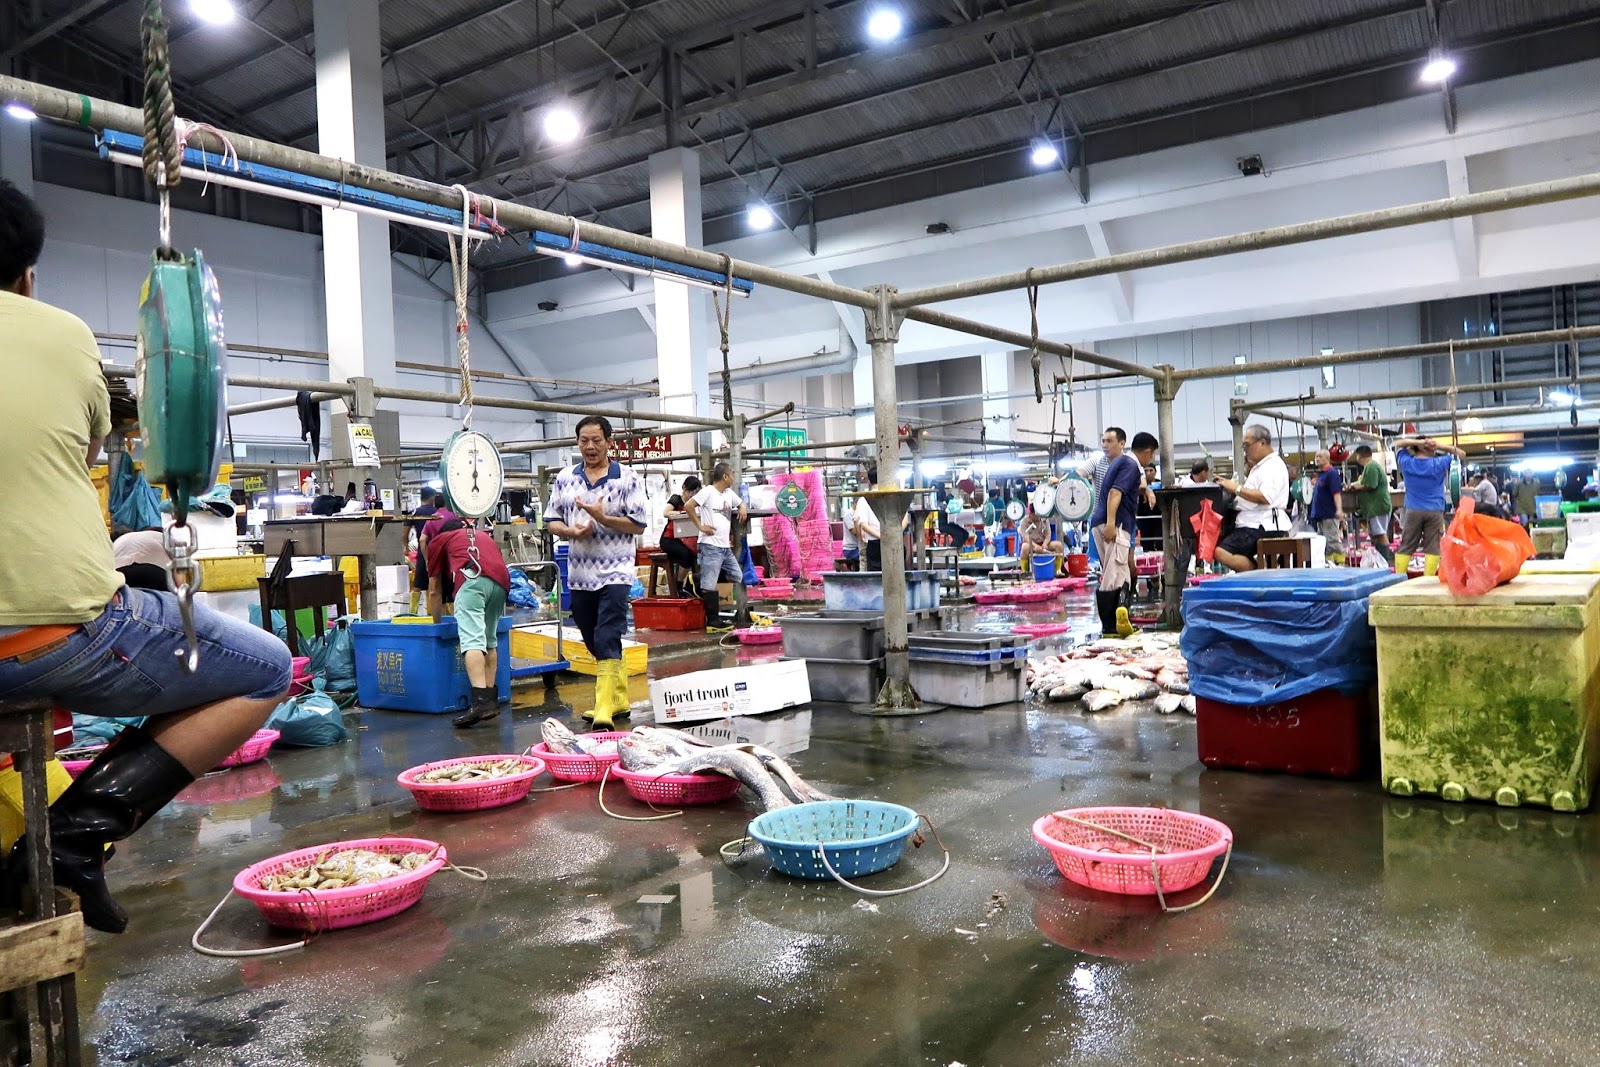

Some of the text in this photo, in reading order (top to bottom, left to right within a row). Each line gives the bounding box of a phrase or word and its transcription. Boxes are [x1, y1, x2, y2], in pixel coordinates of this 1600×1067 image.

[633, 450, 645, 459] FISH
[646, 450, 672, 458] MERCHANT
[664, 689, 694, 707] fjord
[697, 685, 730, 702] trout
